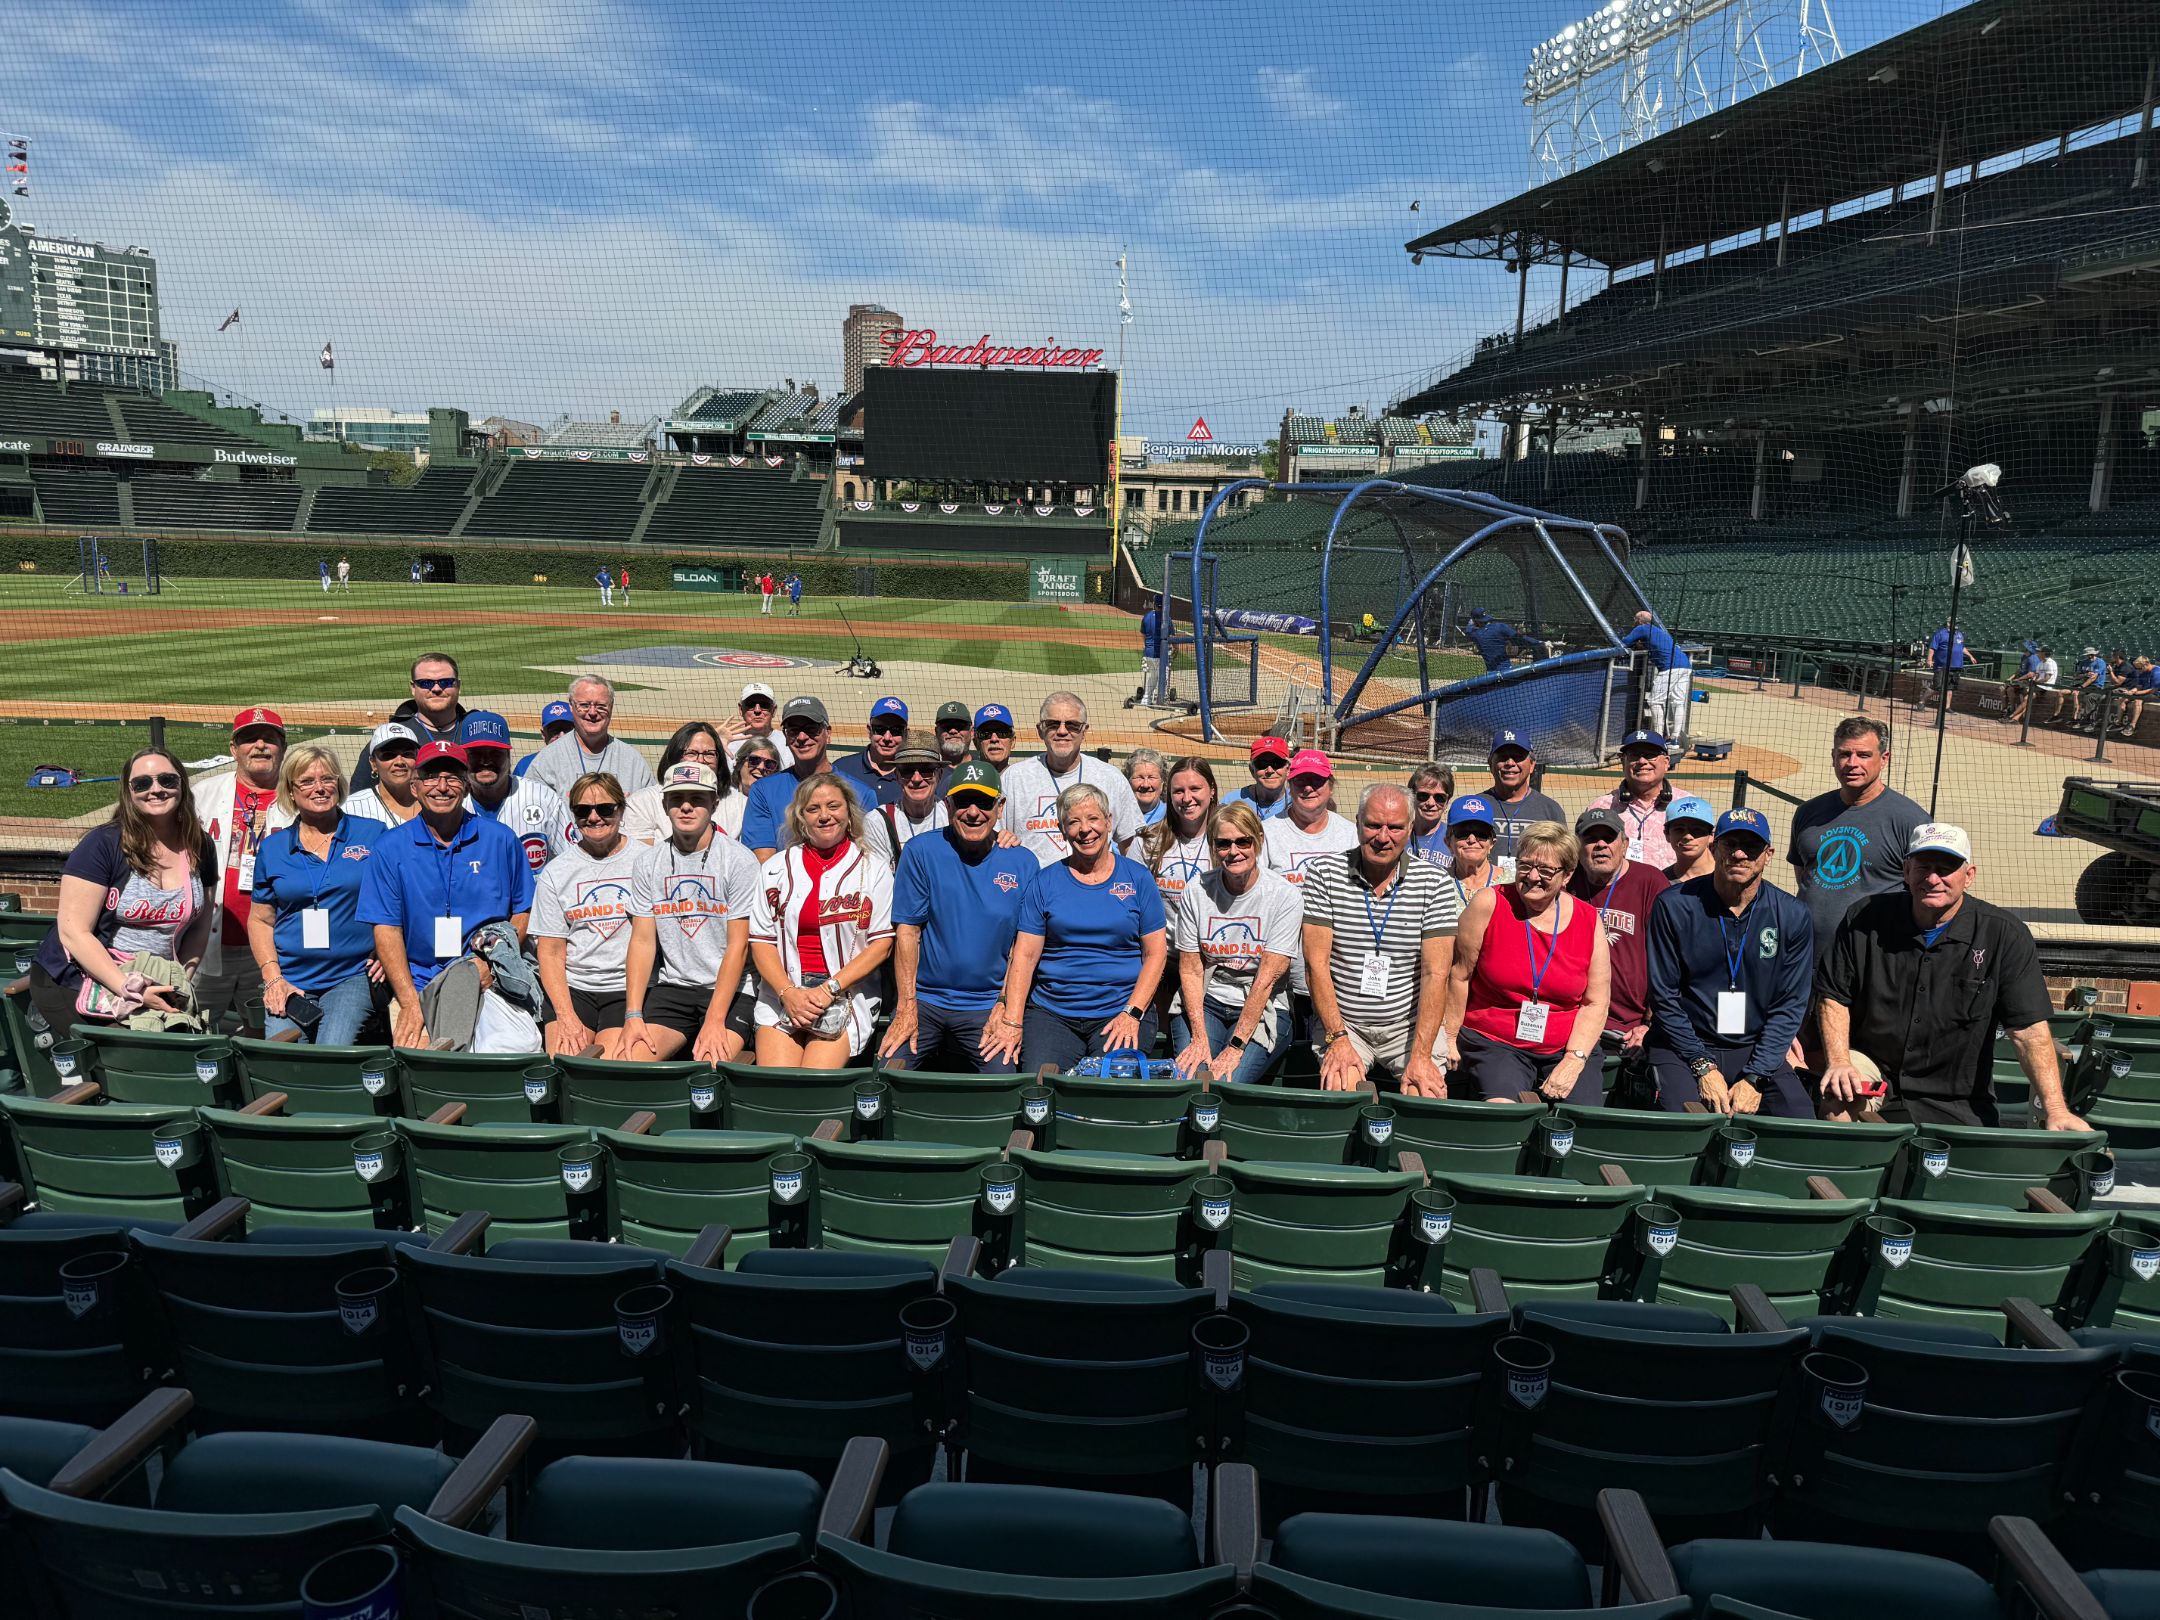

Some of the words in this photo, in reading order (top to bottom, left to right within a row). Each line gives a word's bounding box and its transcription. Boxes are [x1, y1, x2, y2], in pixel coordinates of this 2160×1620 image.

[28, 239, 95, 259] AMERICAN
[880, 328, 1104, 367] Budweiser
[96, 442, 154, 454] GRAINGER
[1141, 442, 1208, 457] Benjamin
[1210, 443, 1258, 457] Moore
[1302, 446, 1376, 455] WRIGLEYROOFTOPS.COM
[1399, 447, 1474, 456] WRIGLEYROOFTOPS.COM
[214, 449, 297, 465] Budweiser
[1037, 574, 1078, 584] DRAFT
[1043, 582, 1076, 590] KINGS
[467, 720, 503, 738] CHICAGO
[1504, 730, 1516, 741] LA
[1636, 730, 1648, 741] LA
[435, 740, 451, 752] T
[963, 765, 984, 782] A's
[526, 808, 541, 821] 14
[1591, 811, 1604, 820] NY
[1025, 819, 1059, 831] GRAN
[469, 860, 481, 874] T
[124, 899, 169, 920] Red
[565, 903, 614, 921] GRAND
[652, 902, 694, 916] GRAND
[696, 902, 729, 914] SLAM
[1242, 943, 1265, 955] SLA
[42, 1036, 48, 1045] 3
[1554, 1139, 1571, 1147] 1914
[157, 1149, 178, 1157] 1914
[357, 1161, 378, 1170] 1914
[566, 1171, 588, 1180] 1914
[776, 1181, 798, 1189] 1914
[990, 1192, 1012, 1200] 1914
[1205, 1208, 1227, 1216] 1914
[1425, 1222, 1448, 1230] 1914
[1652, 1236, 1675, 1244] 1914
[1886, 1247, 1909, 1255] 1914
[342, 1310, 371, 1319] 1914
[622, 1329, 651, 1340] 1914
[910, 1344, 939, 1355] 1914
[1209, 1364, 1239, 1374] 1914
[1514, 1382, 1544, 1393] 1914
[1829, 1400, 1860, 1412] 1914
